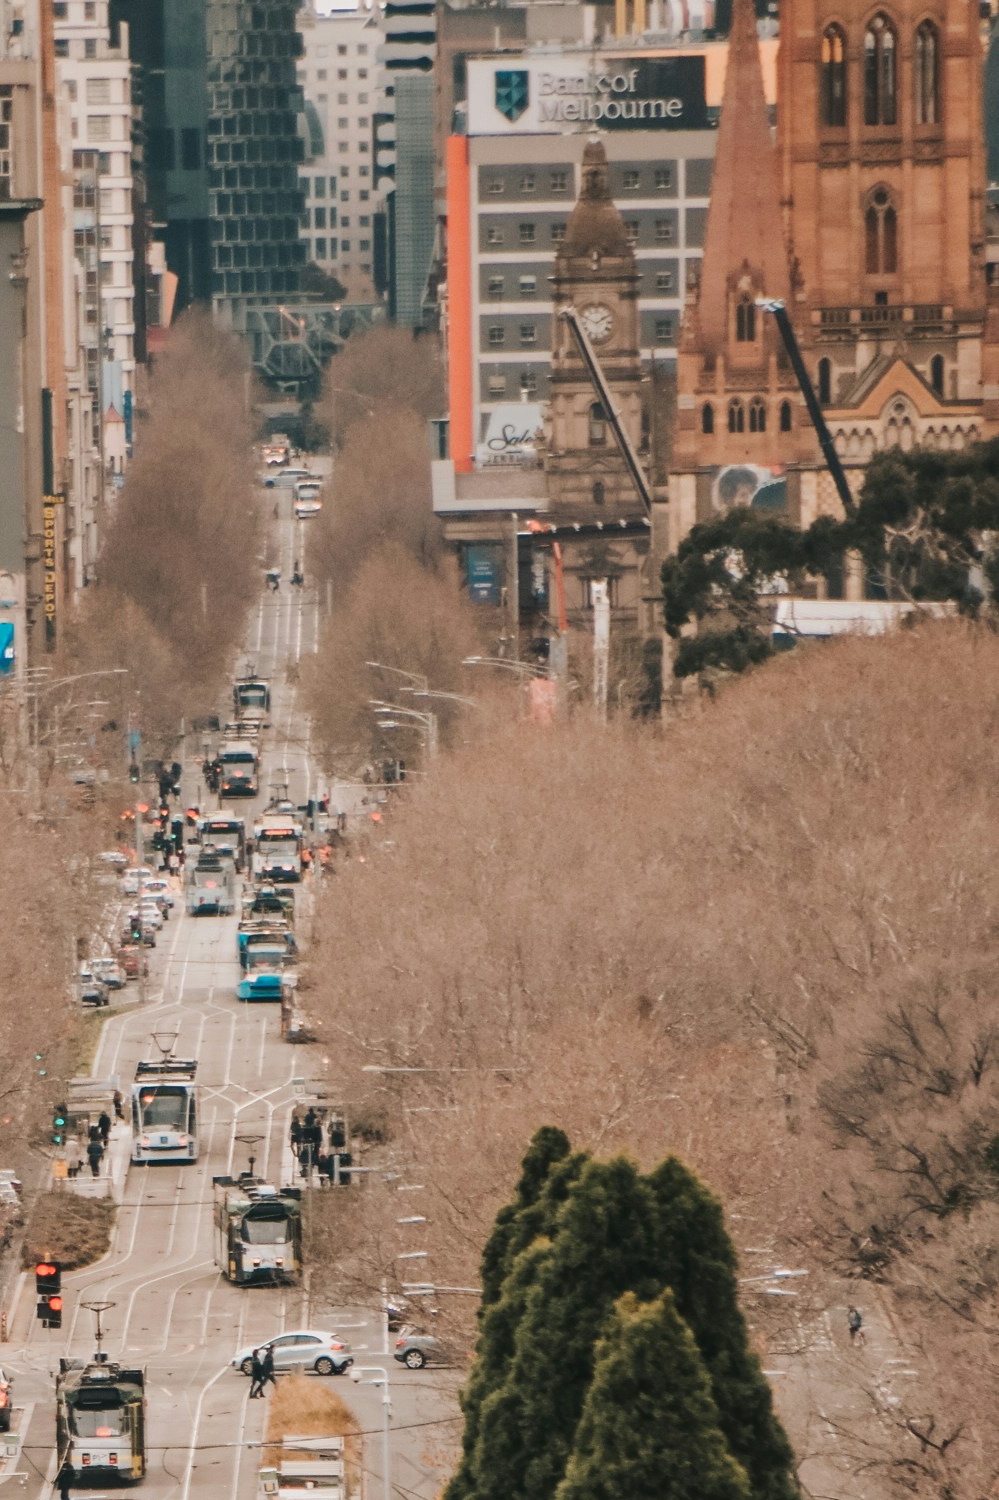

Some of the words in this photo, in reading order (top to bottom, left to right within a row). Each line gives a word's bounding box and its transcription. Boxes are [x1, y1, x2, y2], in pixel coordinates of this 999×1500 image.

[537, 70, 611, 96] Bank
[611, 69, 639, 93] of
[537, 95, 683, 122] Melbourne
